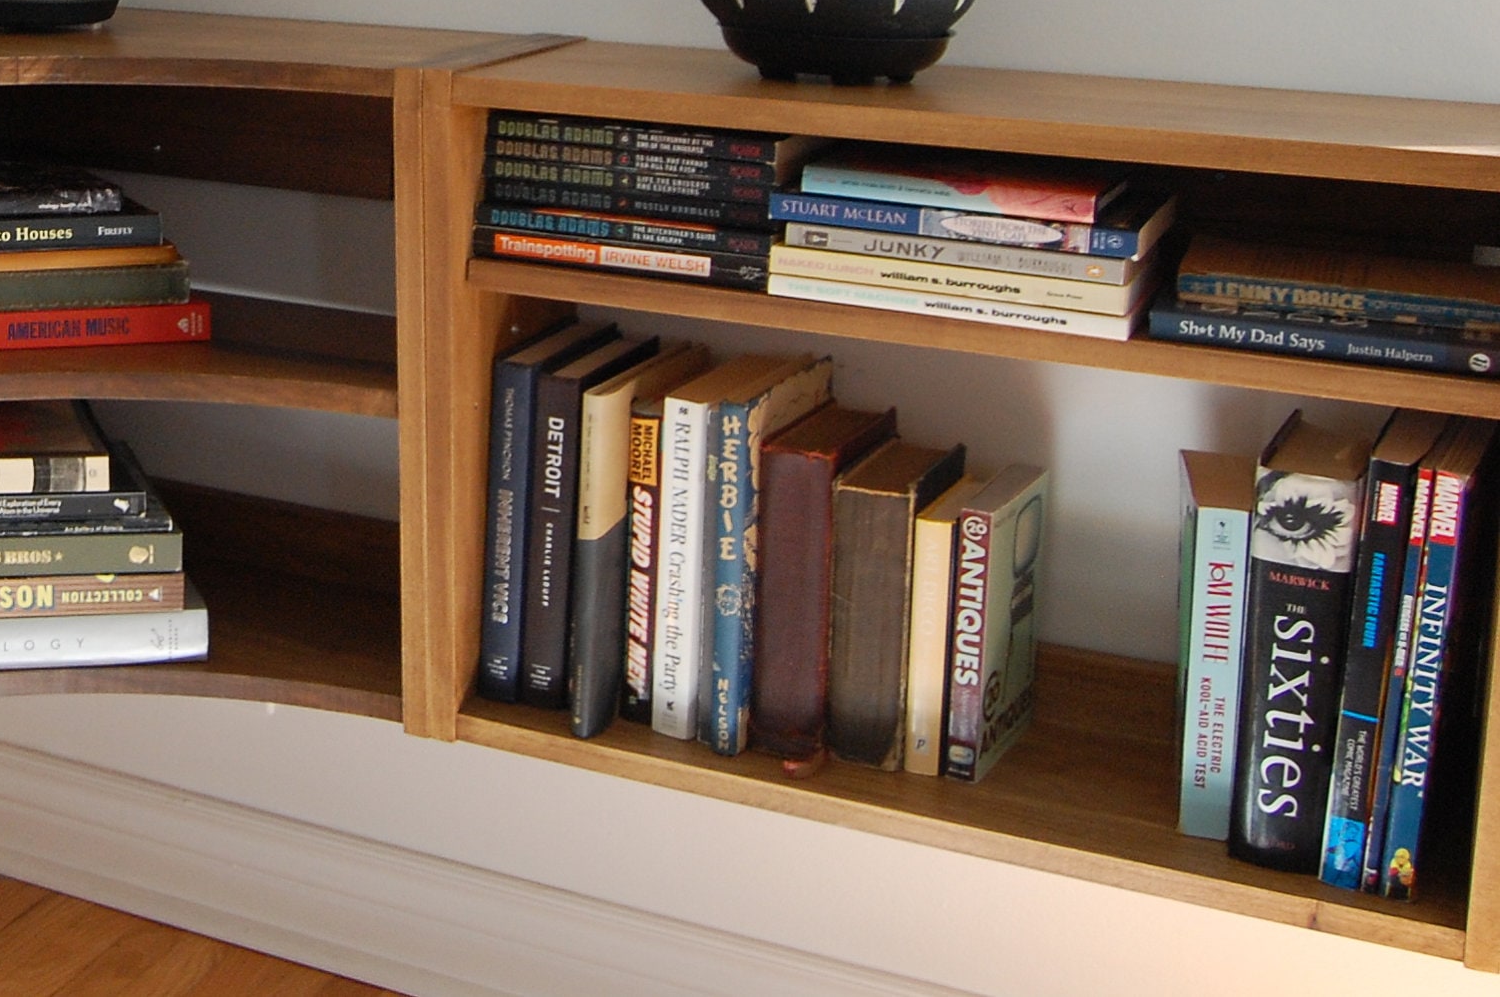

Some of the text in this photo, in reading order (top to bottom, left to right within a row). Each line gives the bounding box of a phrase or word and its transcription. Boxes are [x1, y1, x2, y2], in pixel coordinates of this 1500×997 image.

[498, 121, 614, 145] DOUGLAS ADAMS
[496, 141, 613, 165] DOUGLAS ADAMS
[495, 161, 613, 186] DOUGLAS ADAMS
[495, 184, 612, 208] DOUGLAS ADAMS
[780, 200, 837, 219] STUART
[16, 227, 73, 242] Houses
[98, 226, 133, 236] FIREFLY
[491, 209, 610, 236] DOUGLAS ADAMS
[500, 235, 596, 263] Trainspotting
[604, 247, 707, 274] IRVINE WELSH
[863, 239, 947, 259] JUNKY
[880, 270, 1021, 295] william s. burroughs
[1212, 281, 1292, 303] LENNY
[1295, 288, 1365, 311] BRUCE
[7, 317, 129, 341] AMERICAN MUSIC
[924, 299, 1067, 326] william s. burroughs
[1218, 325, 1325, 352] My Dad Says
[1347, 343, 1434, 364] Justin Halpern
[504, 388, 515, 429] THOMAS
[544, 417, 564, 498] DETROIT
[631, 423, 642, 479] MOORE
[641, 425, 653, 480] MICHAEL
[670, 423, 691, 545] RALPH NADER
[719, 415, 741, 560] HERBIE
[1377, 483, 1399, 522] MARVEL
[1410, 479, 1430, 538] MARVEL
[1430, 475, 1460, 537] MARVEL
[4, 550, 51, 564] BROS
[492, 489, 514, 624] INHERENT VICE
[545, 523, 554, 565] CHARLIE
[62, 589, 143, 602] COLLECTION
[626, 486, 653, 695] STUPID WHITE MEN
[1269, 571, 1330, 591] MARWICK
[954, 537, 986, 686] ANTIQUES
[1203, 561, 1234, 663] TOM WOLFE
[1285, 603, 1307, 614] THE
[1362, 552, 1386, 648] FANTASTIC FOUR
[659, 551, 684, 694] Crashing the Party
[1401, 582, 1448, 786] INFINITY WAR
[717, 679, 729, 750] NELSON
[1257, 615, 1330, 819] sixties
[1194, 677, 1211, 789] KOOL-AID ACID TEST
[1210, 697, 1225, 774] THE ELECTRIC
